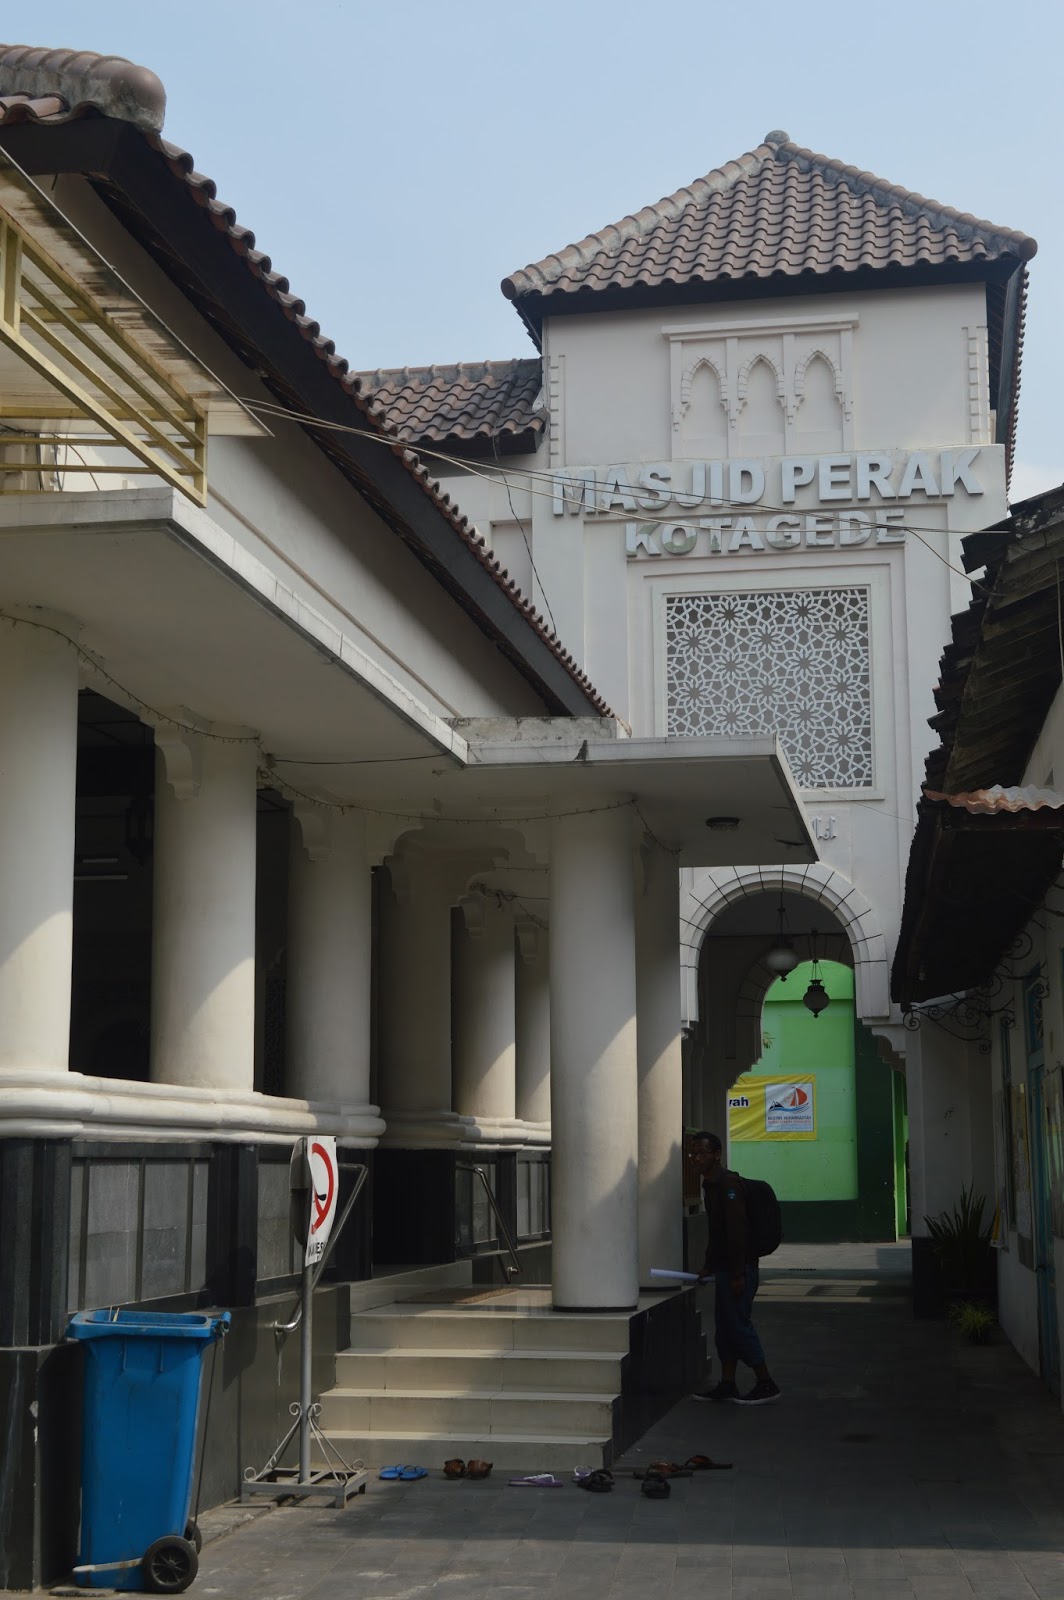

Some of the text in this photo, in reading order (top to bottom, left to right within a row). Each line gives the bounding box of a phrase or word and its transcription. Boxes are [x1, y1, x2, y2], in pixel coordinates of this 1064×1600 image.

[552, 449, 984, 517] MASJID PERAK
[625, 508, 906, 557] KOTAGEDE
